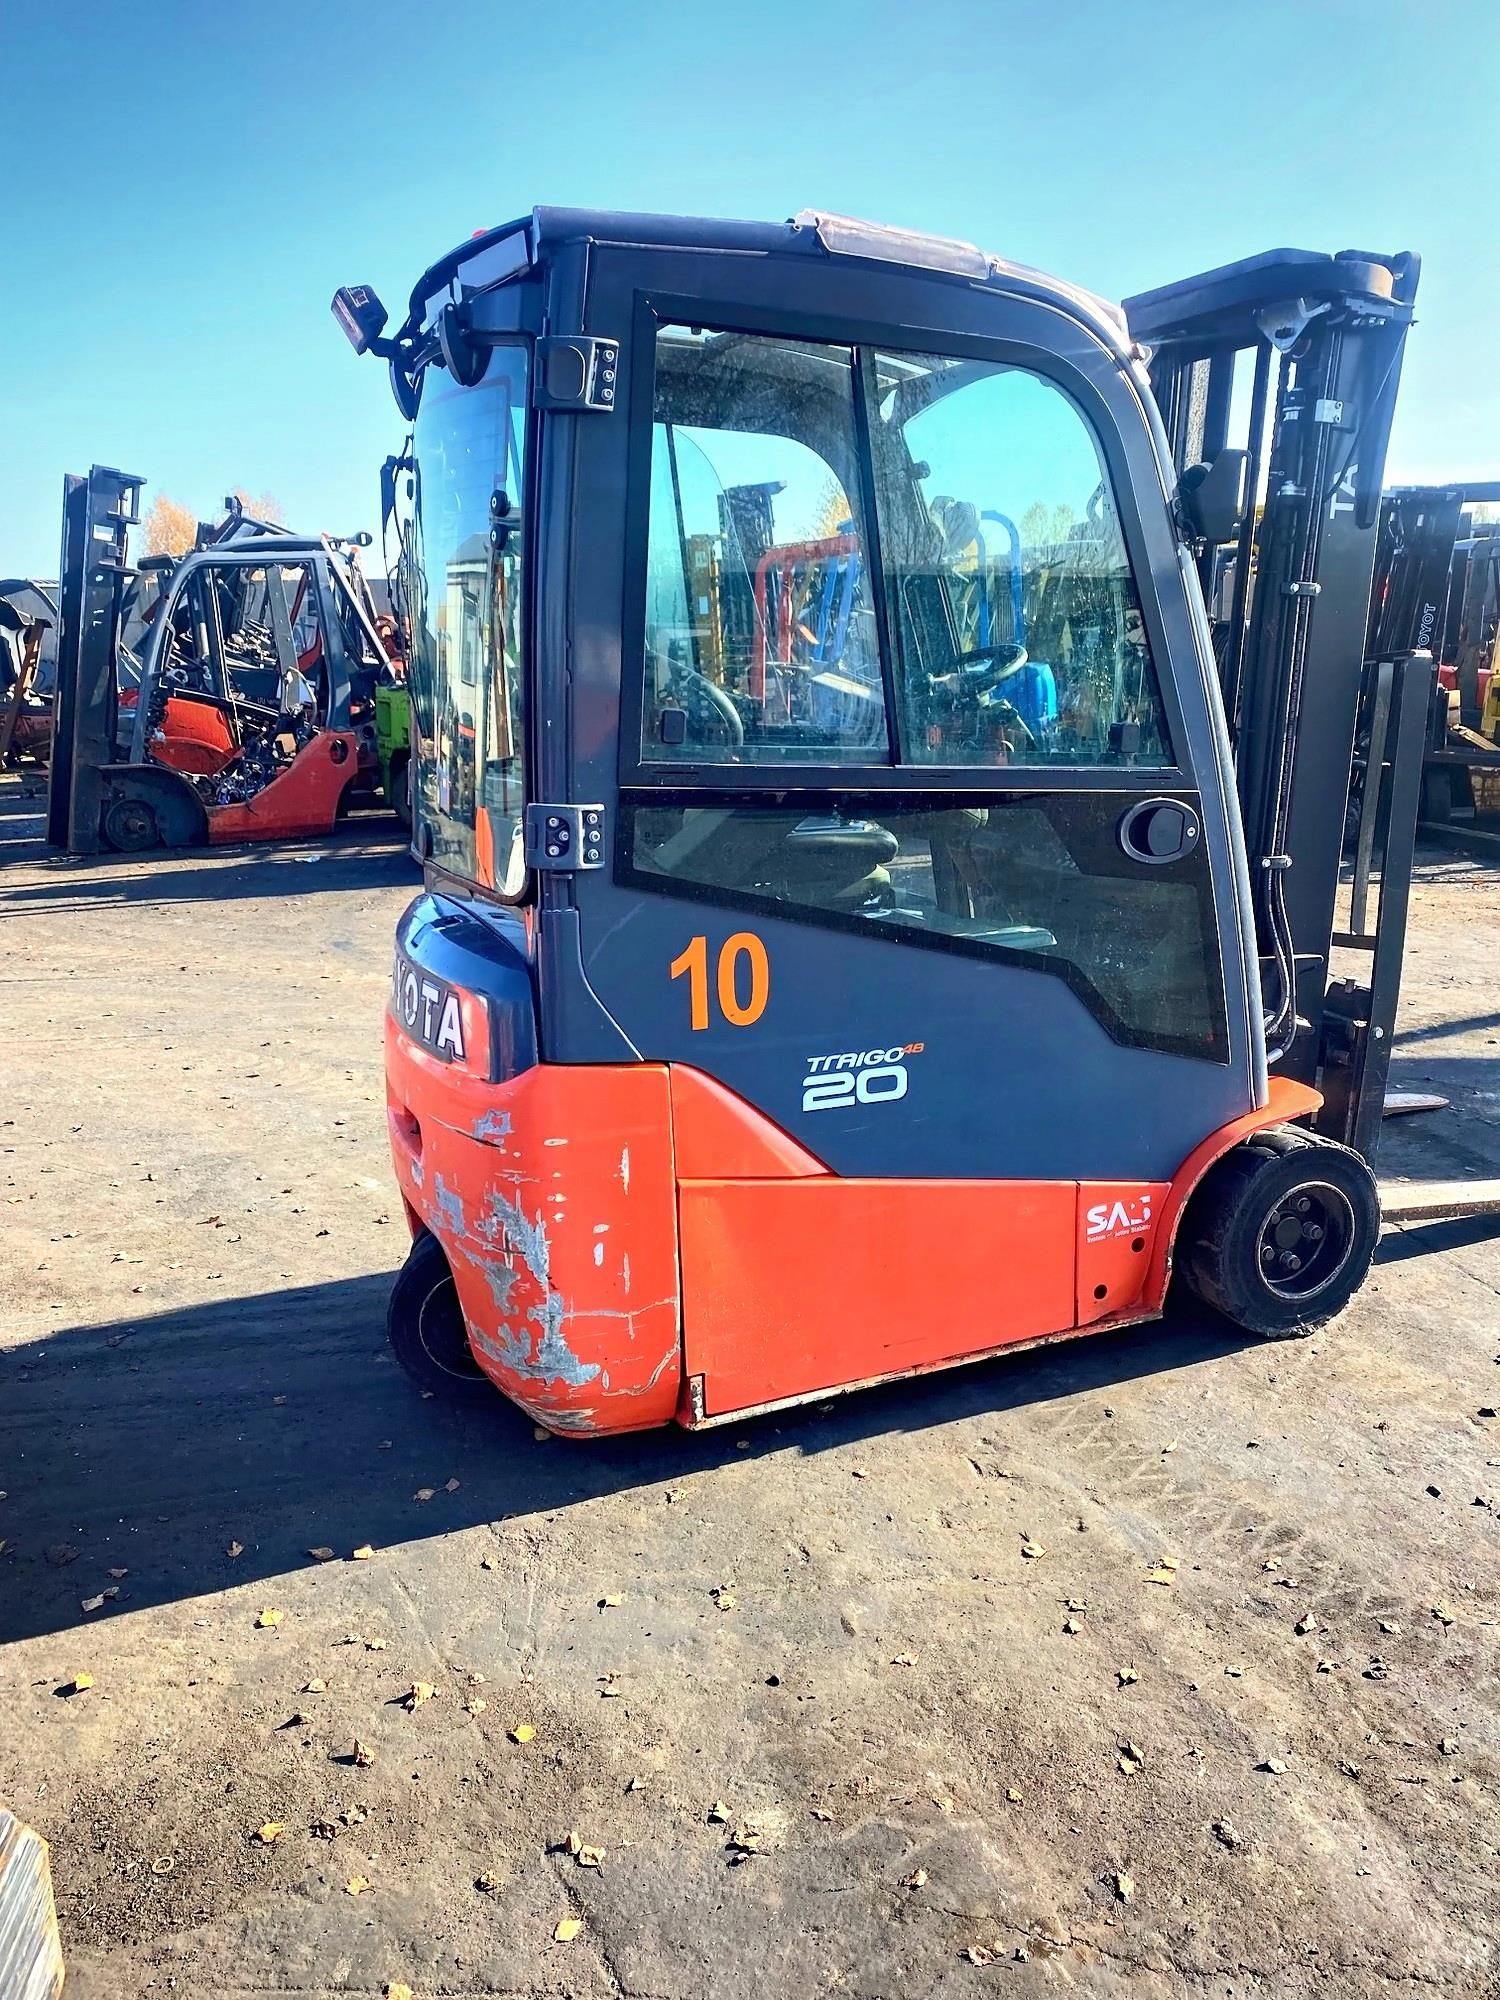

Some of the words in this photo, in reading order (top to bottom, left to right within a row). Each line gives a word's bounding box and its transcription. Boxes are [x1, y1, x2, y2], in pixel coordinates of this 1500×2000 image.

[671, 932, 769, 1030] 10
[901, 1043, 925, 1054] 48
[803, 1065, 908, 1112] 20
